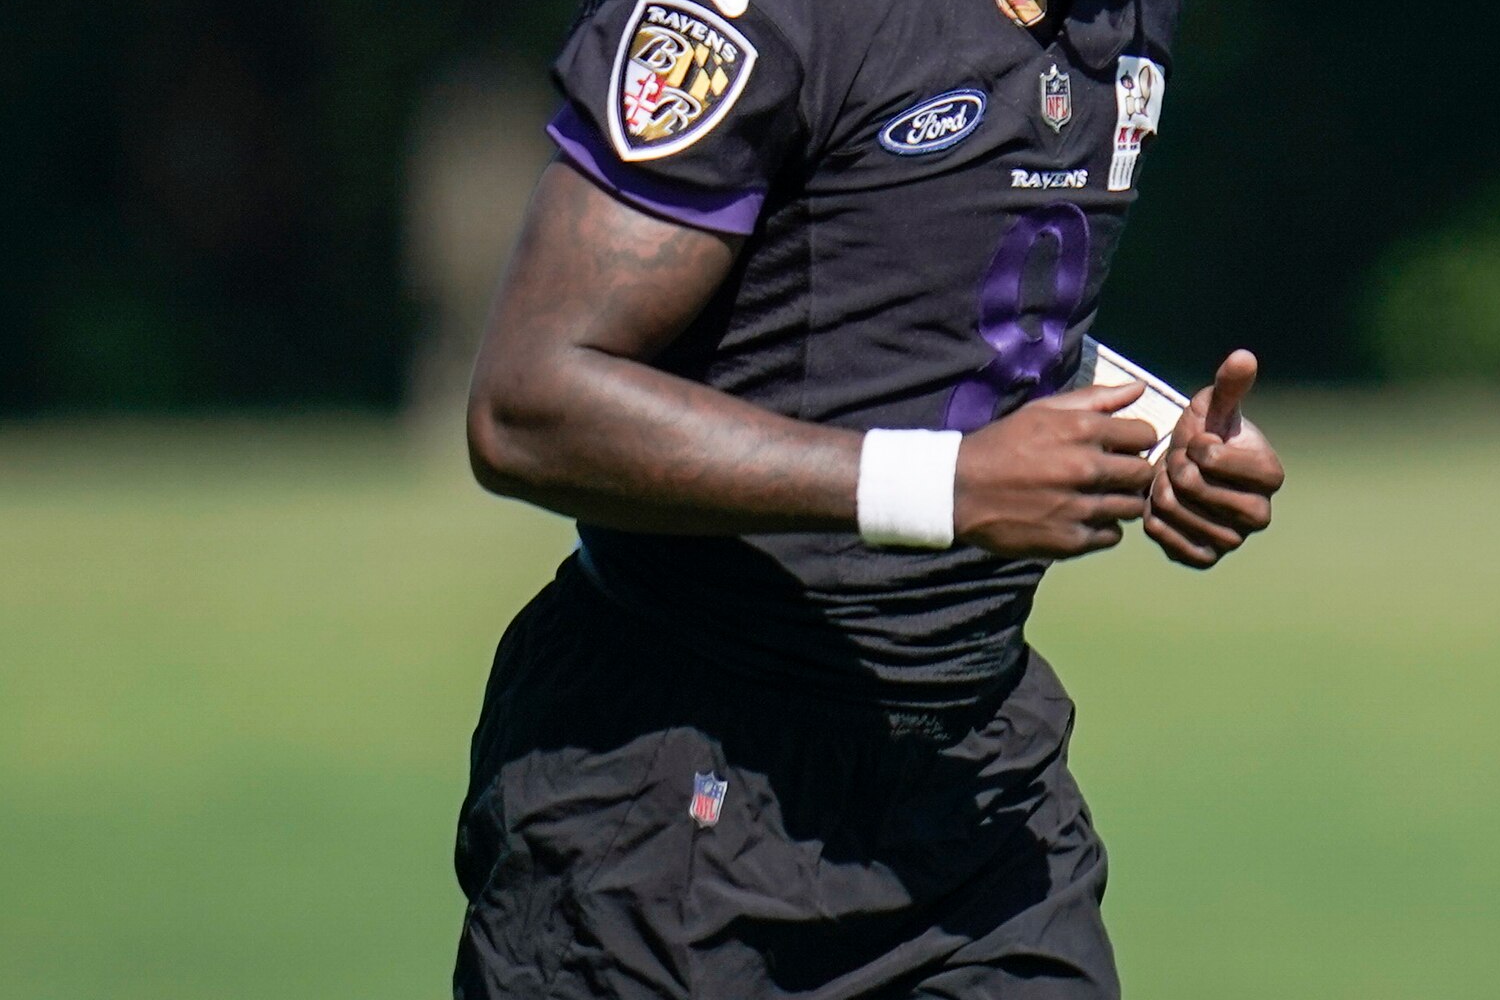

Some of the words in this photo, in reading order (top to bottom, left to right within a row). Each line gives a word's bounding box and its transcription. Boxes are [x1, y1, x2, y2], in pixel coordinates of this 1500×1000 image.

[647, 6, 738, 63] RAVENS
[906, 103, 967, 144] Ford
[1010, 168, 1088, 190] RAVENS
